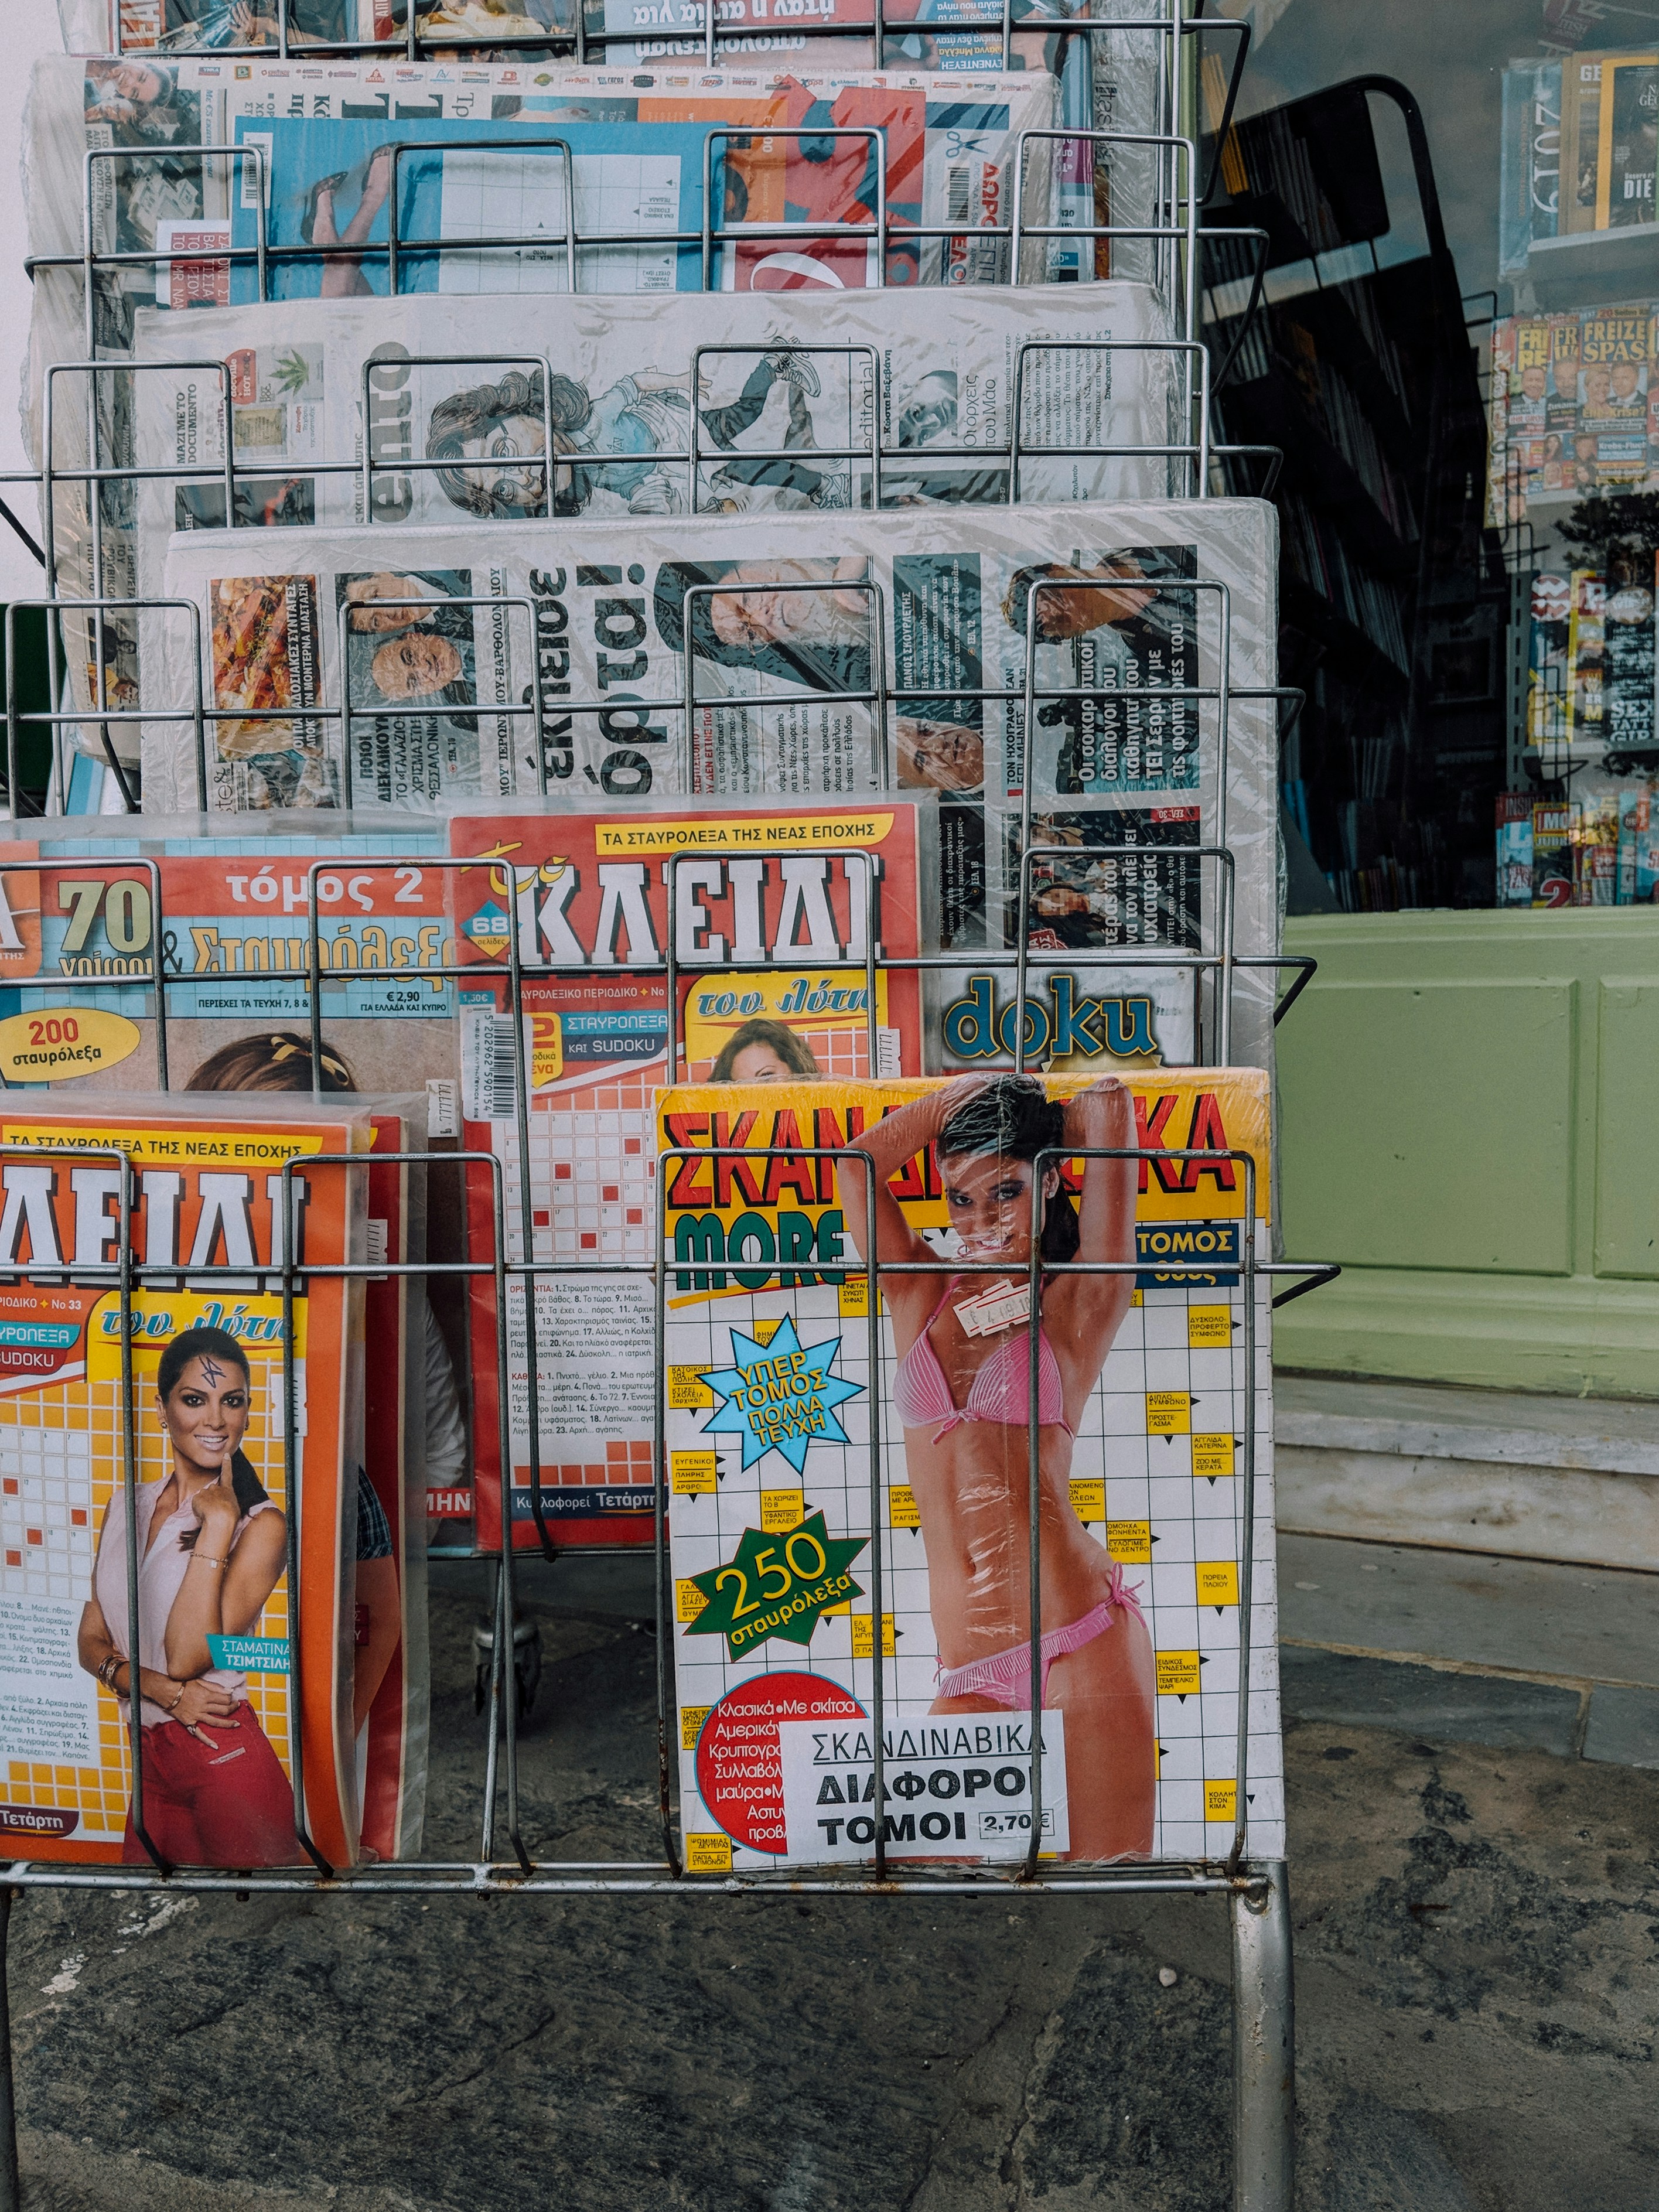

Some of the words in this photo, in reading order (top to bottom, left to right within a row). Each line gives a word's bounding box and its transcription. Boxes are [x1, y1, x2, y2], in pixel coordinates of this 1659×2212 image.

[1623, 179, 1651, 199] DIE
[1104, 351, 1112, 366] στη
[882, 349, 892, 399] Βαξεβάνη
[1104, 366, 1113, 401] Συνέχεια
[176, 392, 186, 408] ΤΟ
[982, 378, 996, 415] Μάο
[176, 411, 186, 430] ΜΕ
[187, 384, 197, 464] DOCUMENTO
[883, 400, 892, 434] Κώστα
[176, 431, 186, 465] ΜΑΖΙ
[963, 429, 977, 447] Οι
[284, 584, 299, 642] ΣΥΝΤΑΓΕΣ
[298, 583, 310, 632] ΔΙΑΣΤΑΣΗ
[900, 592, 913, 655] ΣΚΟΥΡΛΕΤΗΣ
[967, 630, 976, 645] ΣΕΛ.
[1170, 623, 1184, 654] του
[301, 634, 314, 691] ΜΟΝΤΕΡΝΑ
[1148, 649, 1165, 670] με
[902, 656, 913, 689] ΠΑΝΟΣ
[288, 643, 303, 735] ΠΑΑΔΟΣΙΑΚΕΣ
[1609, 699, 1653, 719] SEX
[292, 737, 304, 749] ΟΙ
[409, 720, 423, 743] ΣΤΗ
[776, 713, 787, 769] Συνταγματικής
[358, 736, 374, 780] ΠΟΙΟΙ
[411, 745, 424, 794] ΧΡΙΣΜΑ
[1146, 752, 1163, 779] ΤΕΙ
[1172, 756, 1186, 779] τις
[1006, 760, 1016, 785] ΤΟΝ
[1078, 762, 1095, 781] Οι
[395, 783, 409, 800] ΤΟ
[603, 832, 621, 846] ΤΑ
[627, 829, 728, 845] ΣΤΑΥΡΟΛΕΞΑ
[732, 828, 762, 842] ΤΗΣ
[766, 826, 809, 840] ΝΕΑΣ
[812, 823, 876, 838] ΕΠΟΧΗΣ
[971, 871, 979, 885] ΣΕΛ.
[1104, 858, 1118, 890] του
[226, 865, 376, 912] τόμος
[1539, 878, 1571, 909] 2
[58, 879, 152, 953] 70
[1125, 891, 1138, 920] τον
[472, 916, 510, 936] 68
[1101, 894, 1122, 945] τέρας
[1125, 923, 1138, 944] να
[198, 999, 239, 1008] ΠΕΡΙΕΧΕΙ
[241, 999, 252, 1008] ΤΑ
[254, 999, 282, 1008] ΤΕΥΧΗ
[397, 991, 420, 1003] 2,90
[583, 987, 638, 999] ΠΕΡΙΟΔΙΚΟ
[698, 990, 766, 1016] του
[360, 1003, 374, 1012] ΓΙΑ
[376, 1003, 405, 1012] ΕΛΛΑΔΑ
[943, 975, 1158, 1058] doku
[28, 1017, 80, 1047] 200
[12, 1043, 103, 1067] σταυρόλεξα
[568, 1043, 588, 1054] ΚΑΙ
[592, 1038, 655, 1053] SUDOKU
[484, 1071, 493, 1112] 590154
[148, 1140, 180, 1156] ΤΗΣ
[185, 1142, 229, 1157] ΝΕΑΣ
[234, 1144, 302, 1159] ΕΠΟΧΗΣ
[674, 1209, 846, 1292] MORE
[1136, 1230, 1234, 1255] ΤΟΜΟΣ
[562, 1284, 590, 1293] Στρώμα
[51, 1298, 67, 1310] Νο
[68, 1299, 82, 1310] 33
[555, 1316, 610, 1326] Χαρακτηρισμός
[585, 1338, 609, 1348] ηλιακό
[736, 1350, 807, 1387] ΥΠΕΡ
[730, 1368, 828, 1412] ΤΟΜΟΣ
[589, 1415, 602, 1423] 18.
[747, 1395, 825, 1430] ΠΟΛΛΑ
[754, 1412, 826, 1446] ΤΕΥΧΗ
[715, 1531, 827, 1623] 250
[730, 1573, 852, 1646] σταυρόλεξα
[8, 1632, 19, 1641] 15.
[60, 1628, 71, 1637] 13.
[36, 1647, 47, 1655] 18.
[718, 1699, 774, 1718] Κλασικά
[783, 1699, 808, 1715] Με
[810, 1696, 856, 1715] σκίτσα
[813, 1723, 1047, 1762] ΣΚΑΝΔΙΝΑΒΙΚΑ
[716, 1781, 764, 1803] μαύρα
[817, 1811, 967, 1846] ΤΟΜΟΙ
